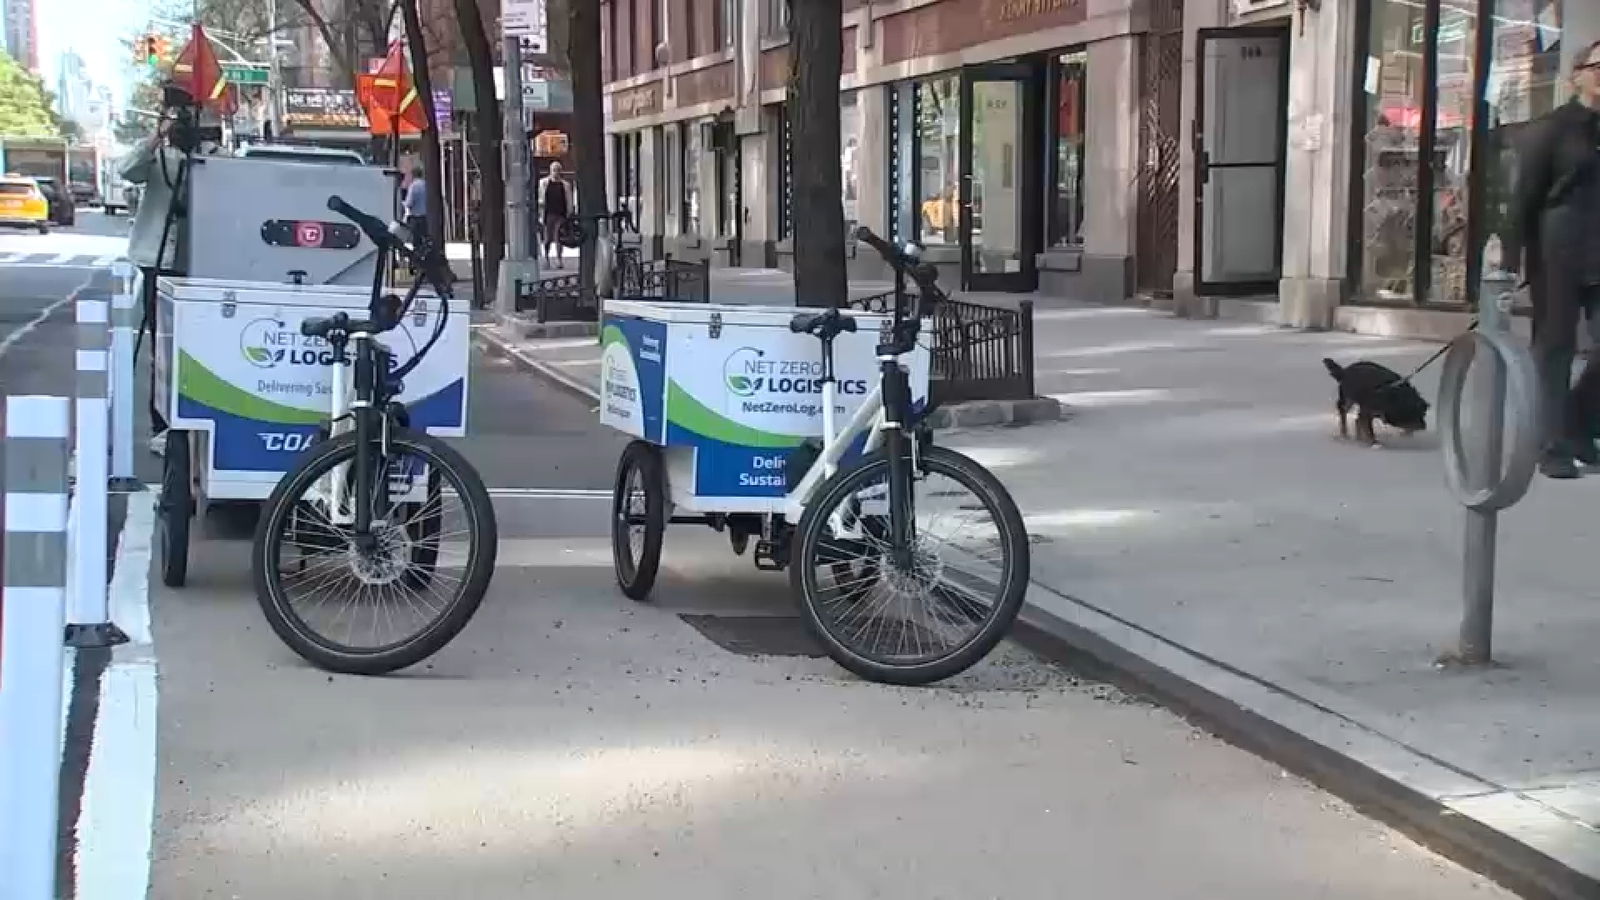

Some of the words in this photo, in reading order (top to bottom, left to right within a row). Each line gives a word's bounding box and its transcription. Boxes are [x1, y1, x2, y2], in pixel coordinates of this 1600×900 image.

[263, 331, 297, 346] NET
[290, 349, 398, 367] LOGSS
[744, 360, 777, 374] NET
[779, 361, 822, 375] ZERO
[257, 379, 314, 397] Delivering
[768, 378, 867, 394] LOGISICS
[742, 401, 845, 417] NetZeroLog.cm
